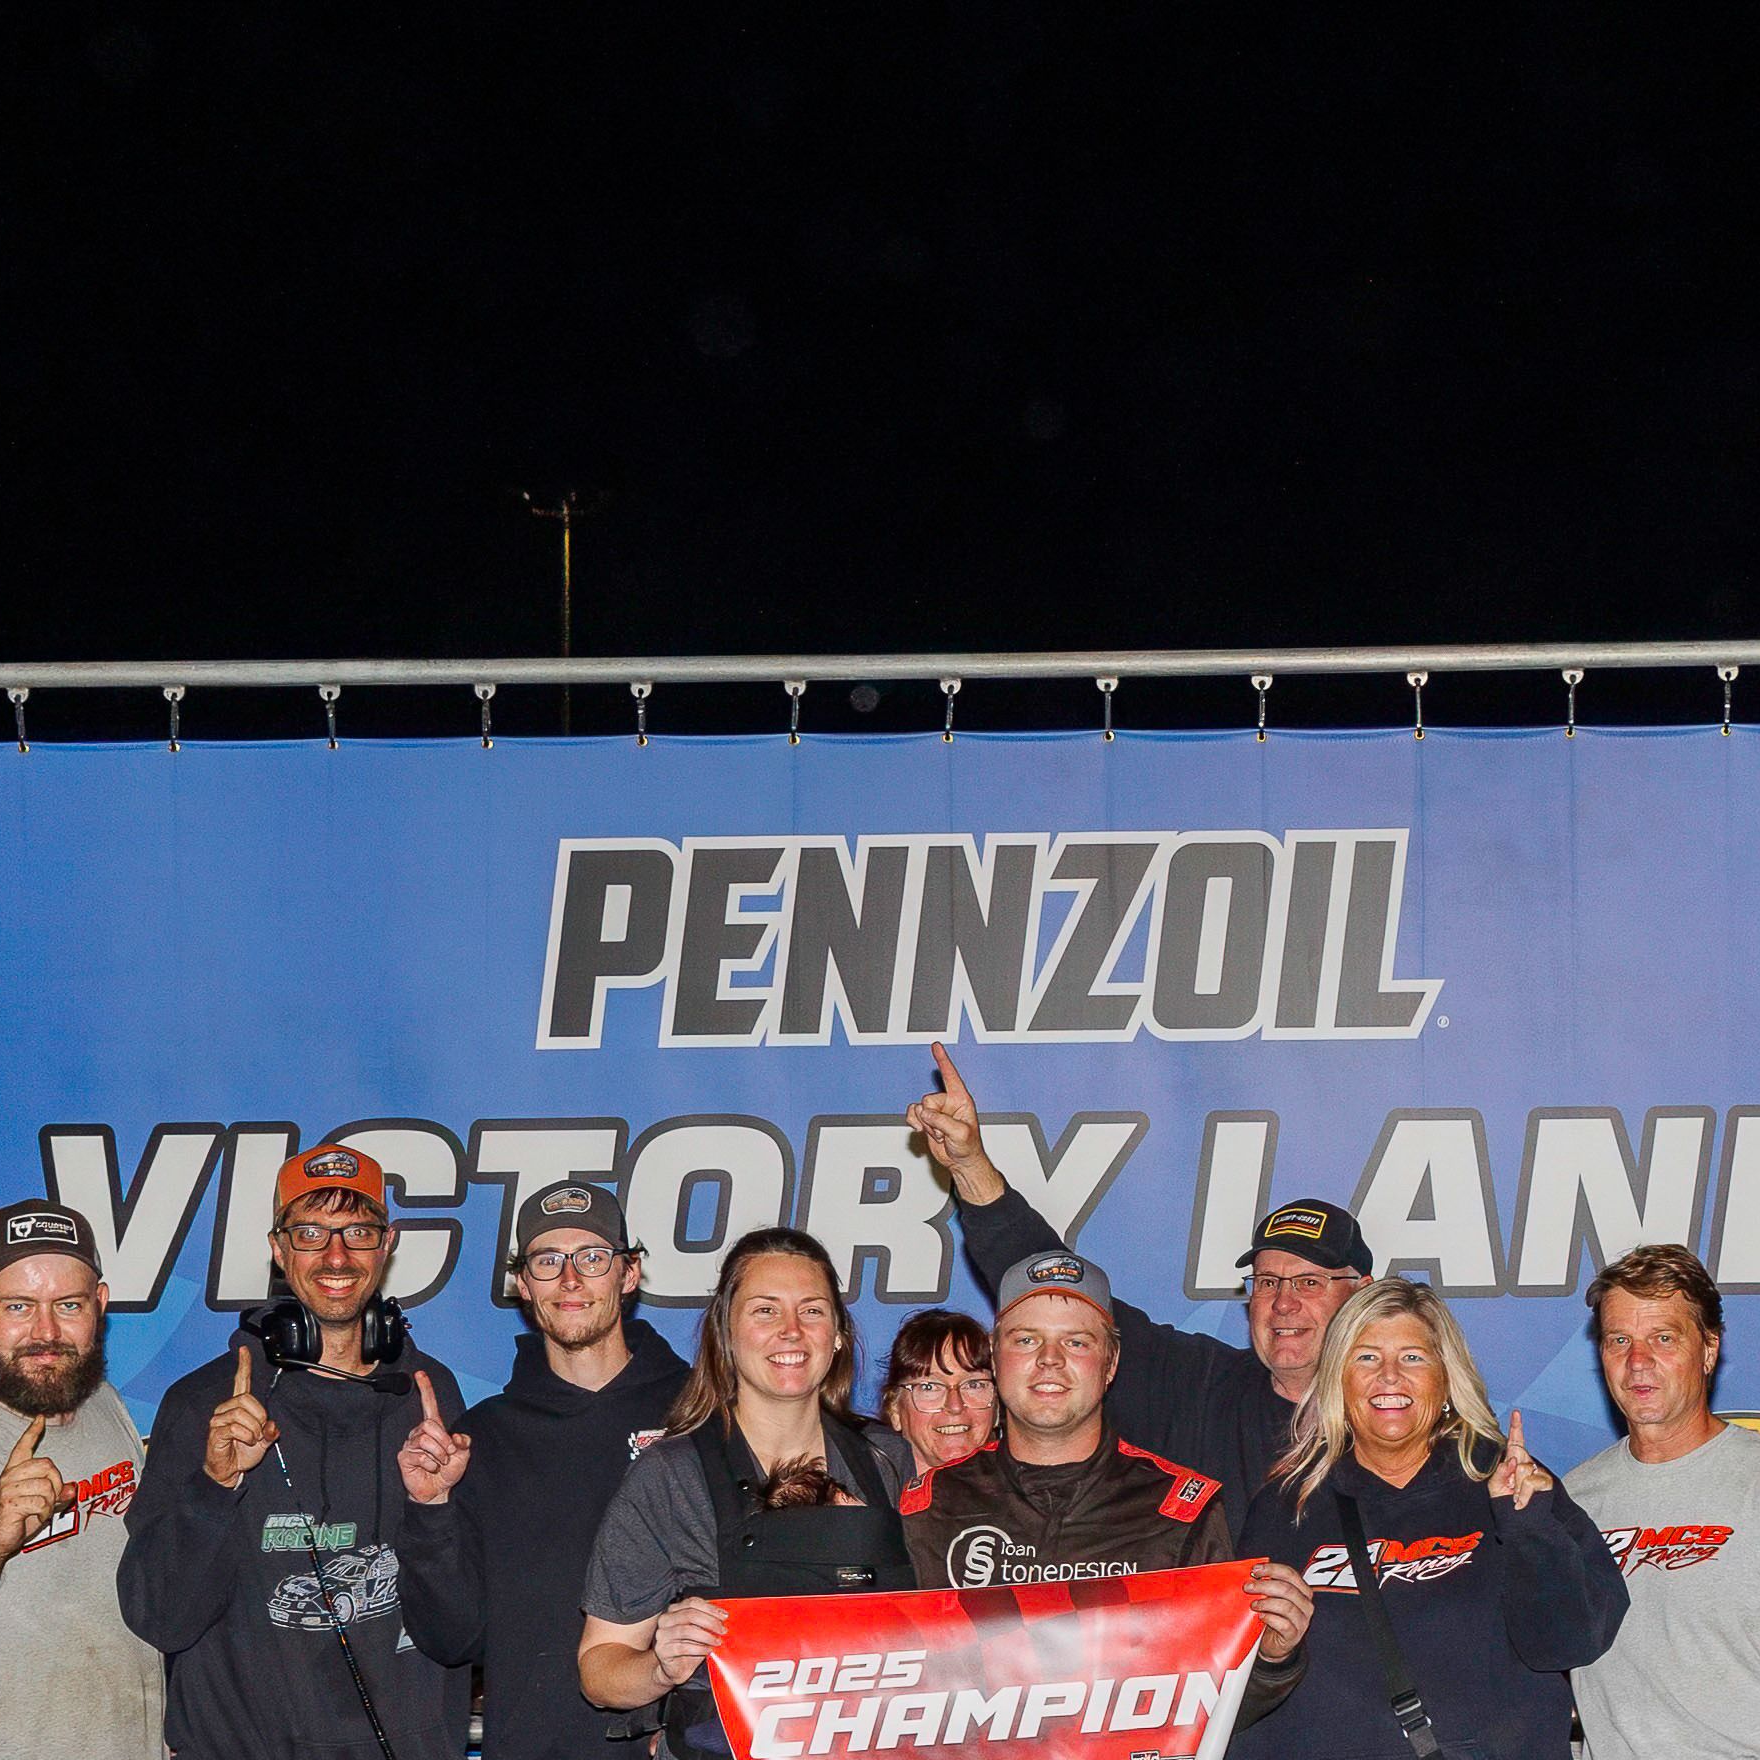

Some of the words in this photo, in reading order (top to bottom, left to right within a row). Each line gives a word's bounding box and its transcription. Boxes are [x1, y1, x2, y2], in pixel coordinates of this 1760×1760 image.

[536, 828, 1444, 1050] PENNZOIL
[41, 1111, 1149, 1310] VICTORY
[77, 1460, 134, 1502] MCB
[1382, 1531, 1484, 1563] MCB
[1637, 1525, 1735, 1549] MCB
[1379, 1551, 1472, 1590] Racing
[1625, 1546, 1720, 1578] Racing
[747, 1650, 928, 1699] 2025
[749, 1669, 1226, 1760] CHAMPION
